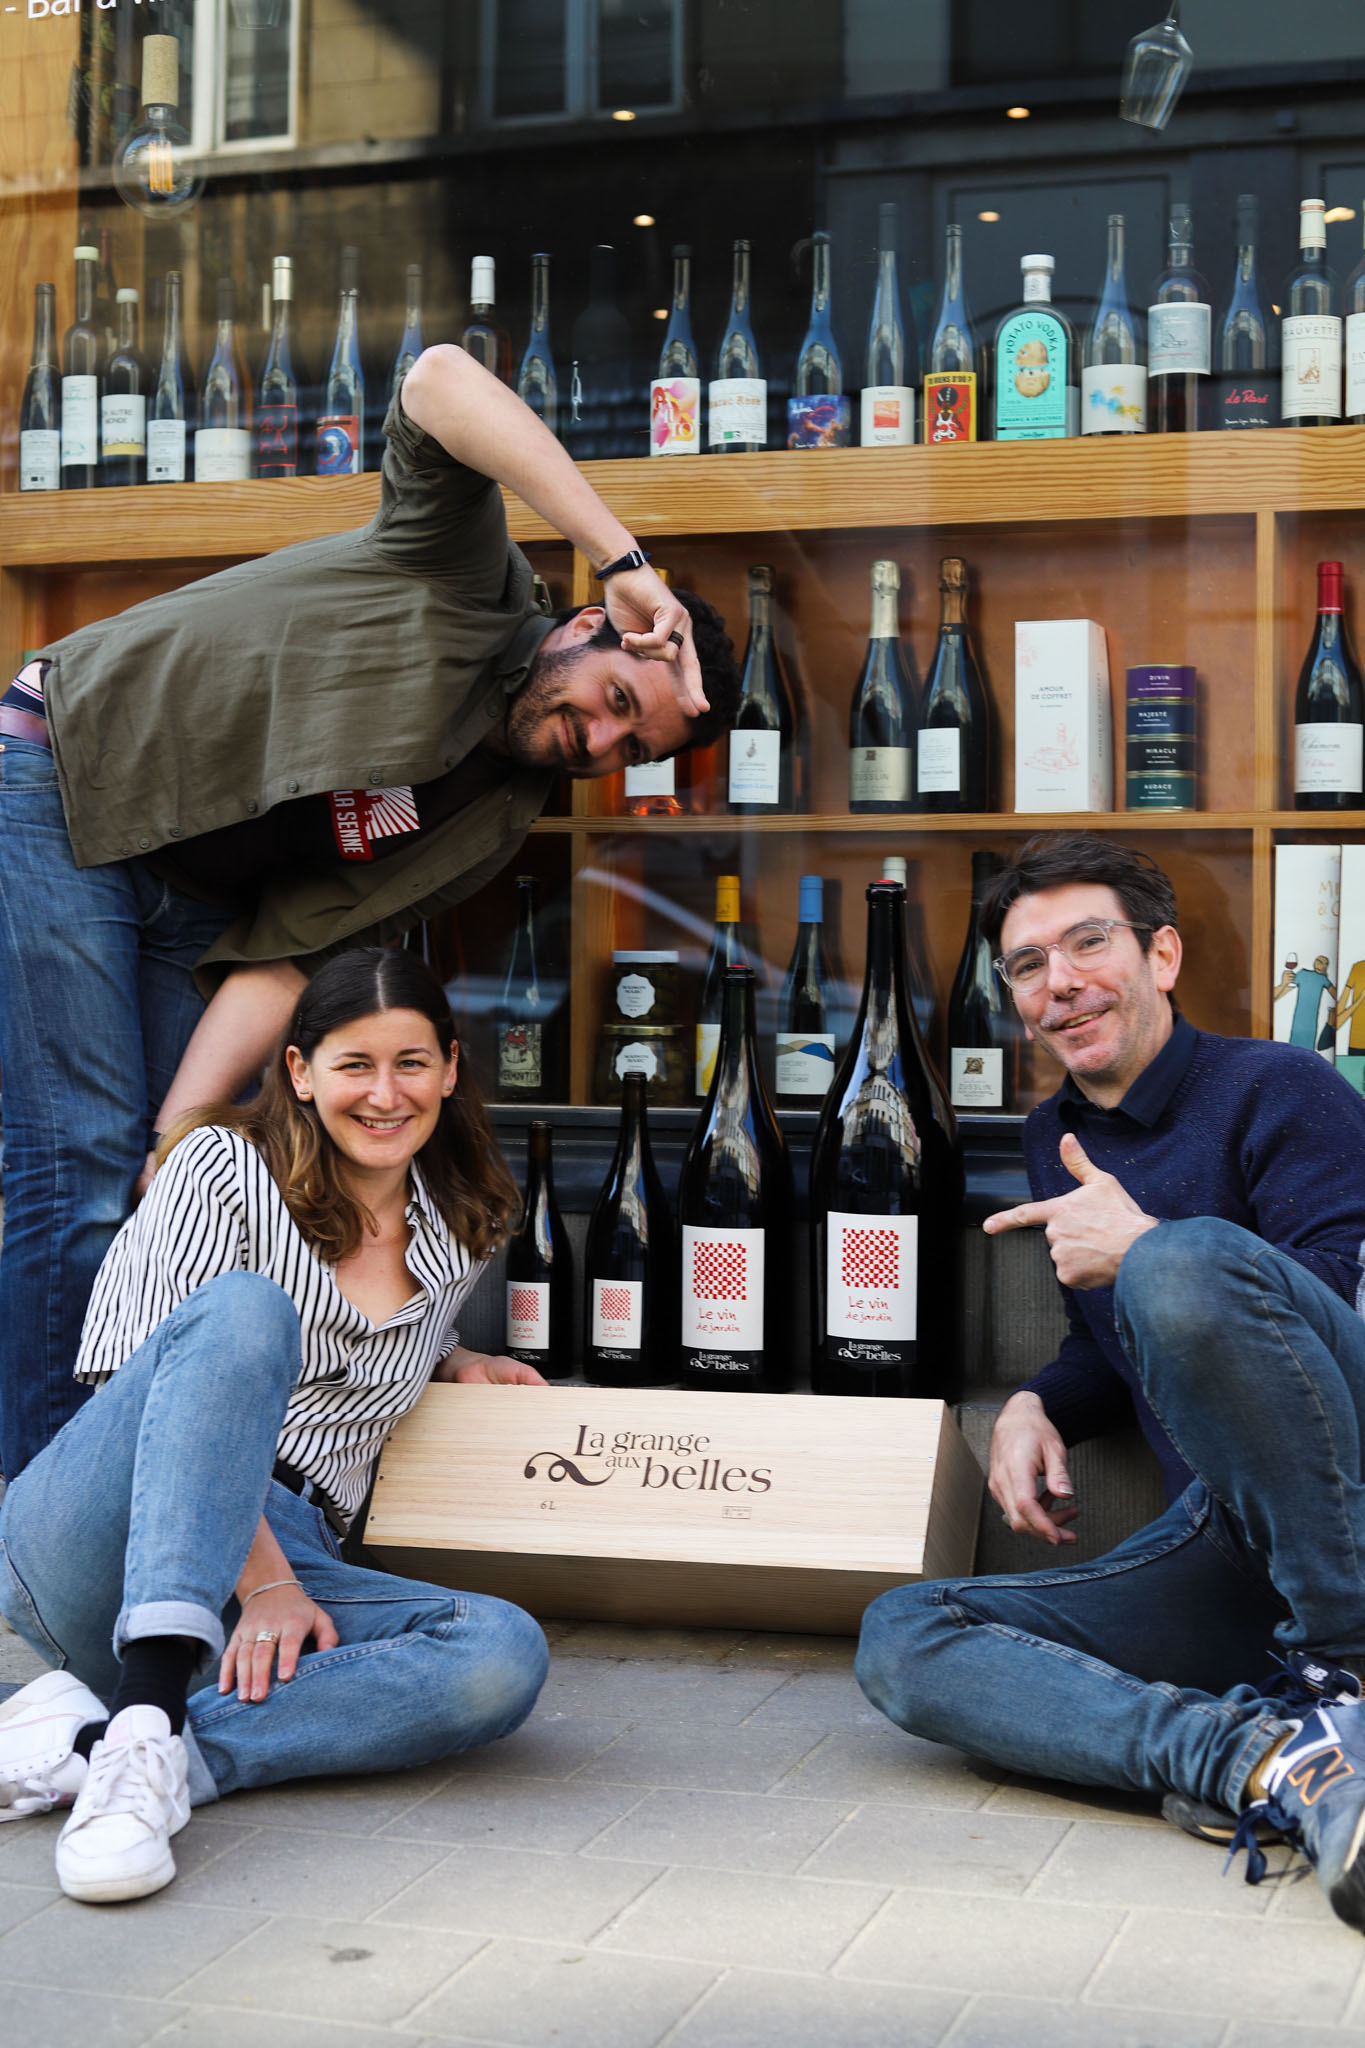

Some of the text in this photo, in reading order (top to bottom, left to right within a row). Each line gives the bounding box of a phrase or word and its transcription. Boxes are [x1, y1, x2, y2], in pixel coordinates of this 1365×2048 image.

[1006, 319, 1059, 354] POTATO VODKA
[1041, 692, 1073, 700] COFFRET
[332, 790, 364, 853] LA SENNE
[848, 1295, 889, 1310] Le vin
[698, 1308, 737, 1321] Le vin
[845, 1311, 893, 1324] de jardin
[695, 1322, 742, 1335] de jardin
[848, 1341, 885, 1352] La grange
[698, 1351, 733, 1362] La grange
[866, 1350, 902, 1361] belles
[715, 1360, 750, 1371] belles
[573, 1425, 710, 1457] La grange
[604, 1454, 772, 1493] aux belles
[540, 1499, 557, 1511] 6L
[1287, 1746, 1355, 1807] N
